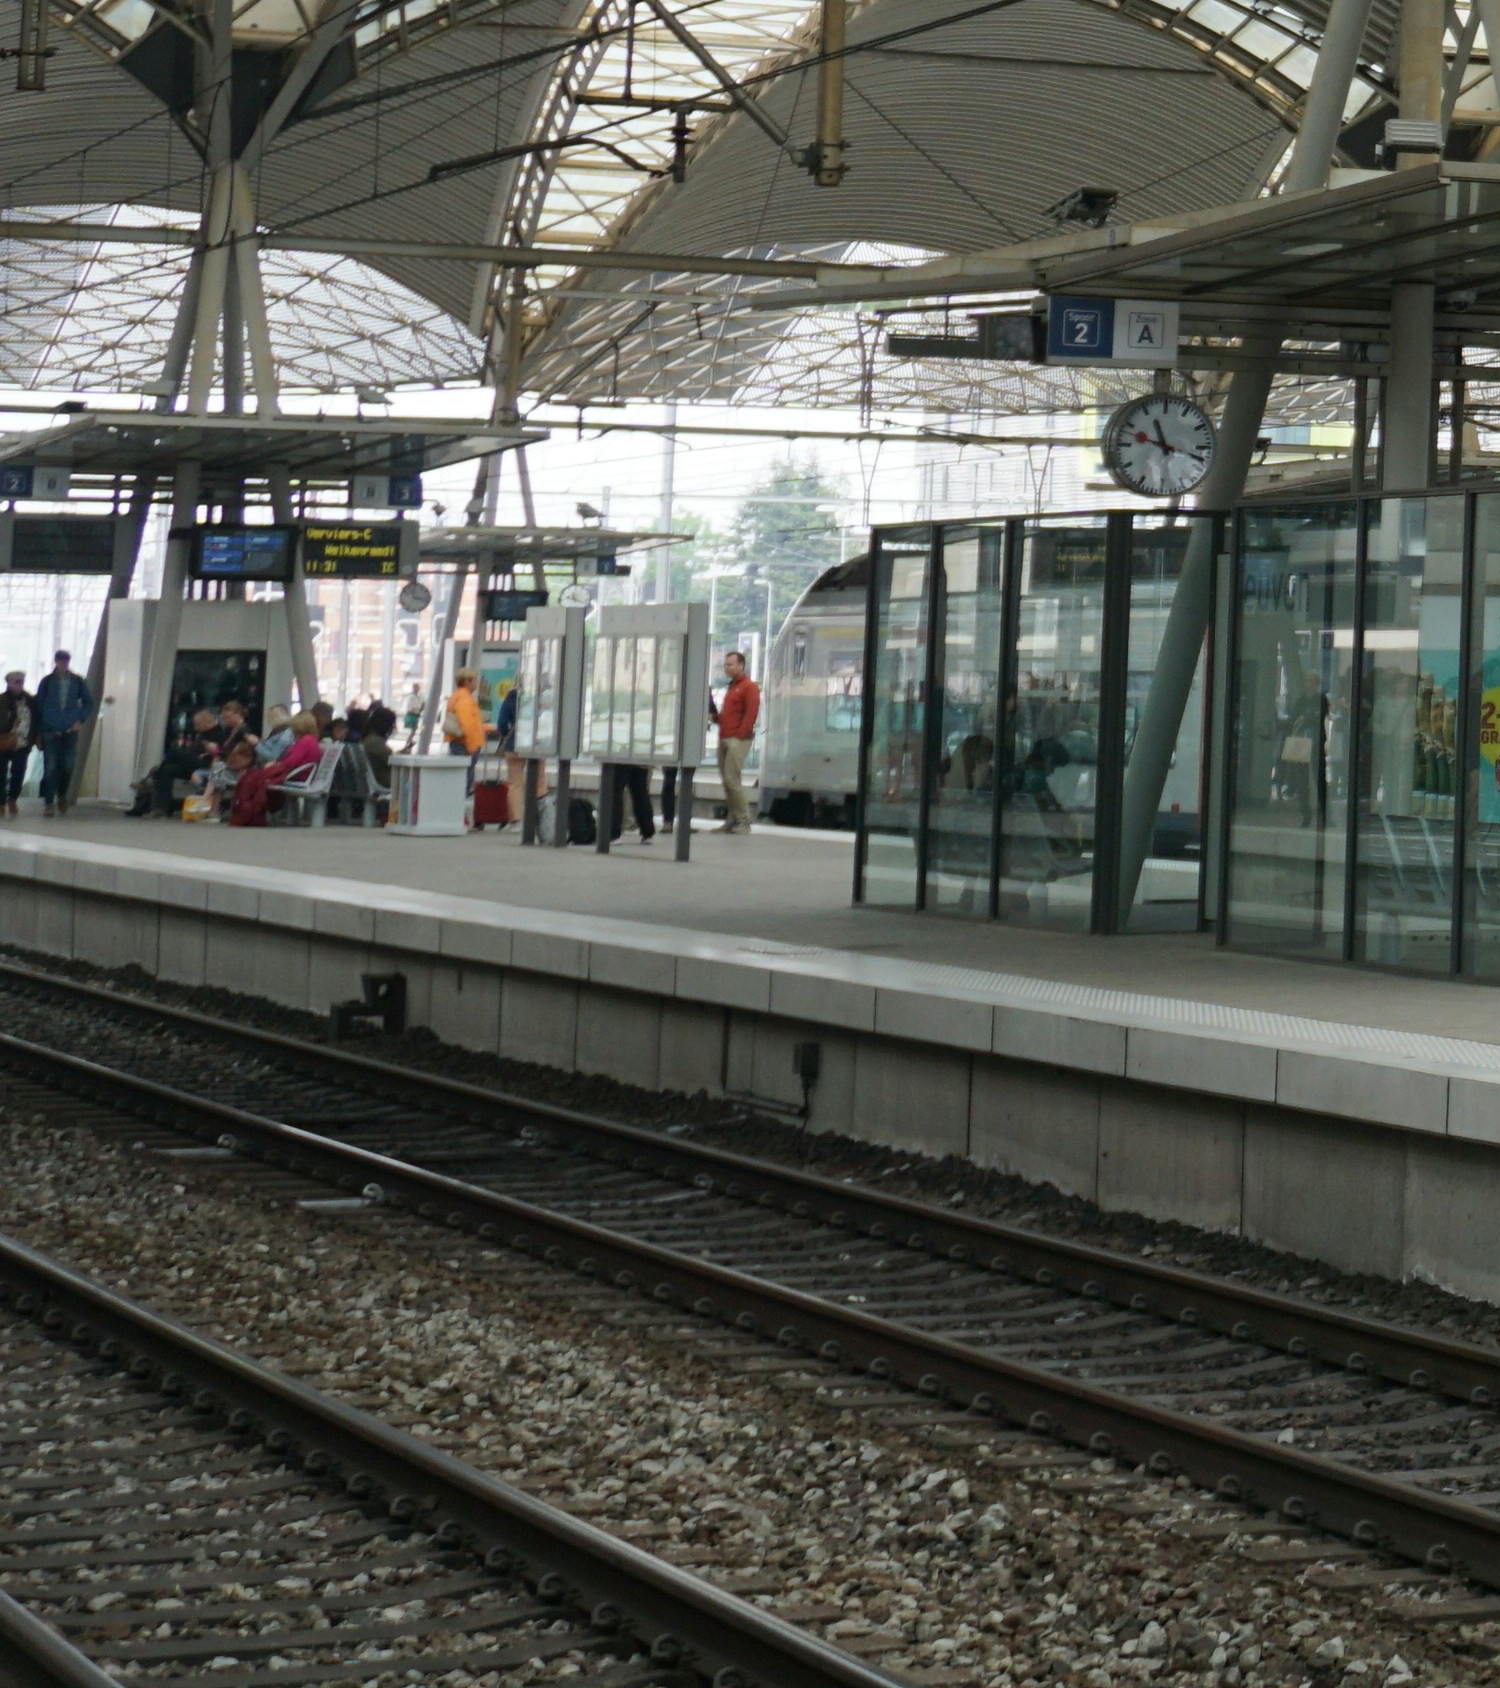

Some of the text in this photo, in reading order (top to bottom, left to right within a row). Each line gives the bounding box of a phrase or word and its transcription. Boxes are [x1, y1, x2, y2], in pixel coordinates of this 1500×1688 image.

[1068, 312, 1095, 322] Spoor
[1074, 323, 1088, 344] 2
[1137, 324, 1153, 344] A
